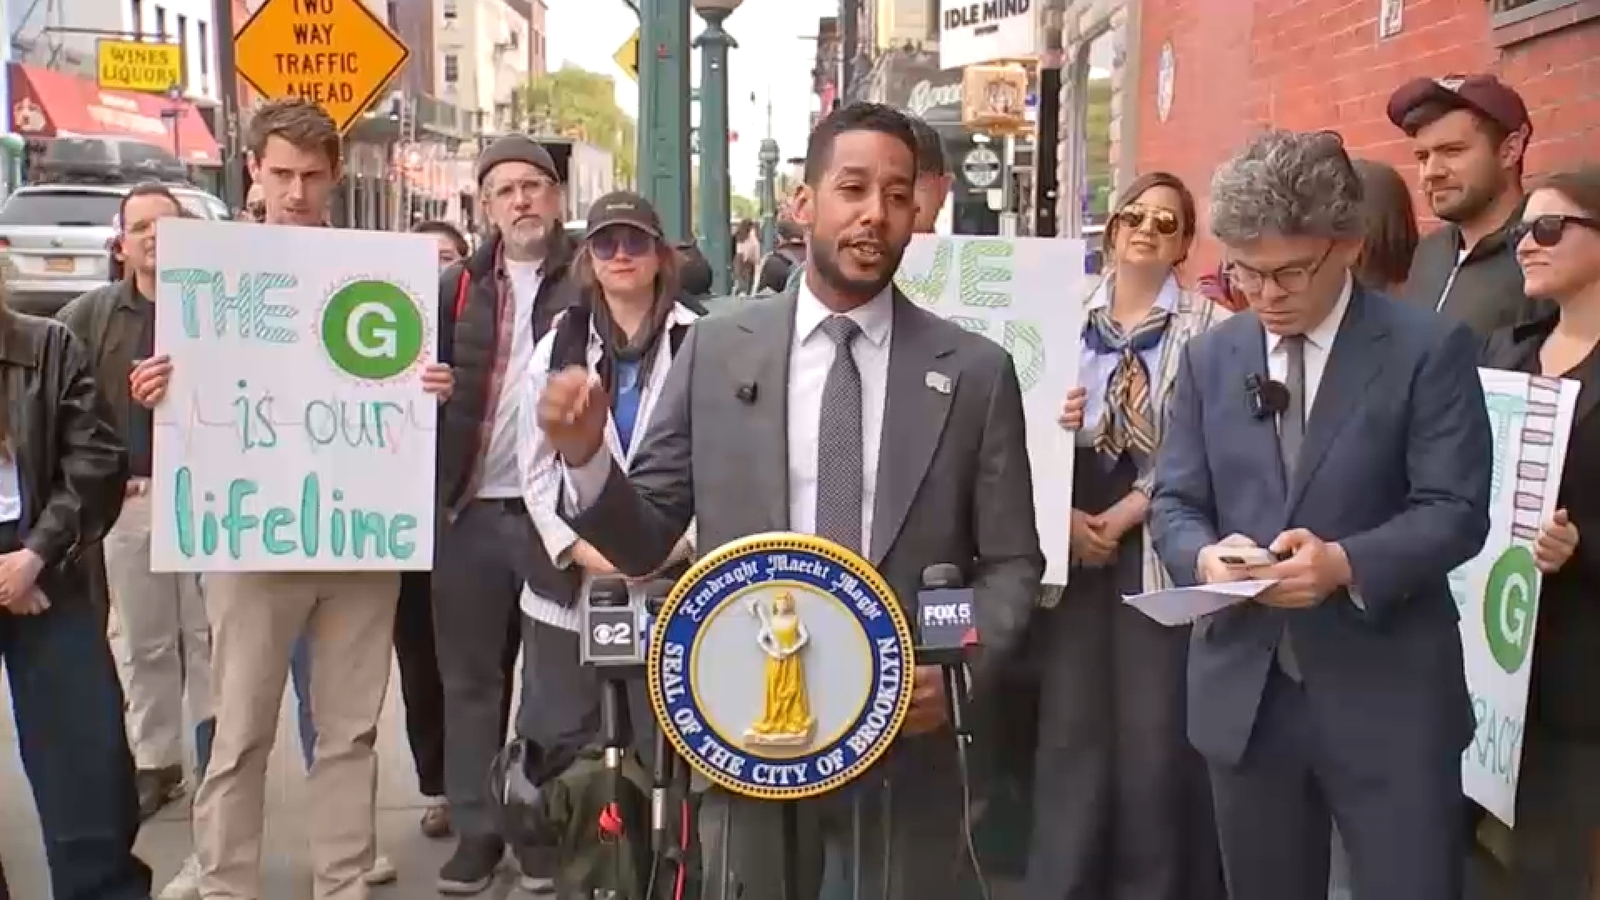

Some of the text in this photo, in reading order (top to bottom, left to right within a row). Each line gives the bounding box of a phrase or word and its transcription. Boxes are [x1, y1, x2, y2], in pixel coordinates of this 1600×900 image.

[293, 0, 333, 14] TWO
[944, 4, 979, 31] IDLE
[982, 0, 1030, 21] MIND
[293, 23, 333, 45] WAY
[110, 47, 169, 65] WINES
[274, 52, 359, 74] TRAFFIC
[103, 64, 176, 86] LIQUORS
[286, 82, 354, 103] AHEAD
[160, 268, 398, 359] THE G
[232, 378, 404, 450] is our
[174, 466, 418, 560] lifeline
[1500, 573, 1529, 648] G
[663, 635, 900, 785] SEAL OF THE CITY OF BROOKLYN
[1466, 693, 1522, 785] RACK
